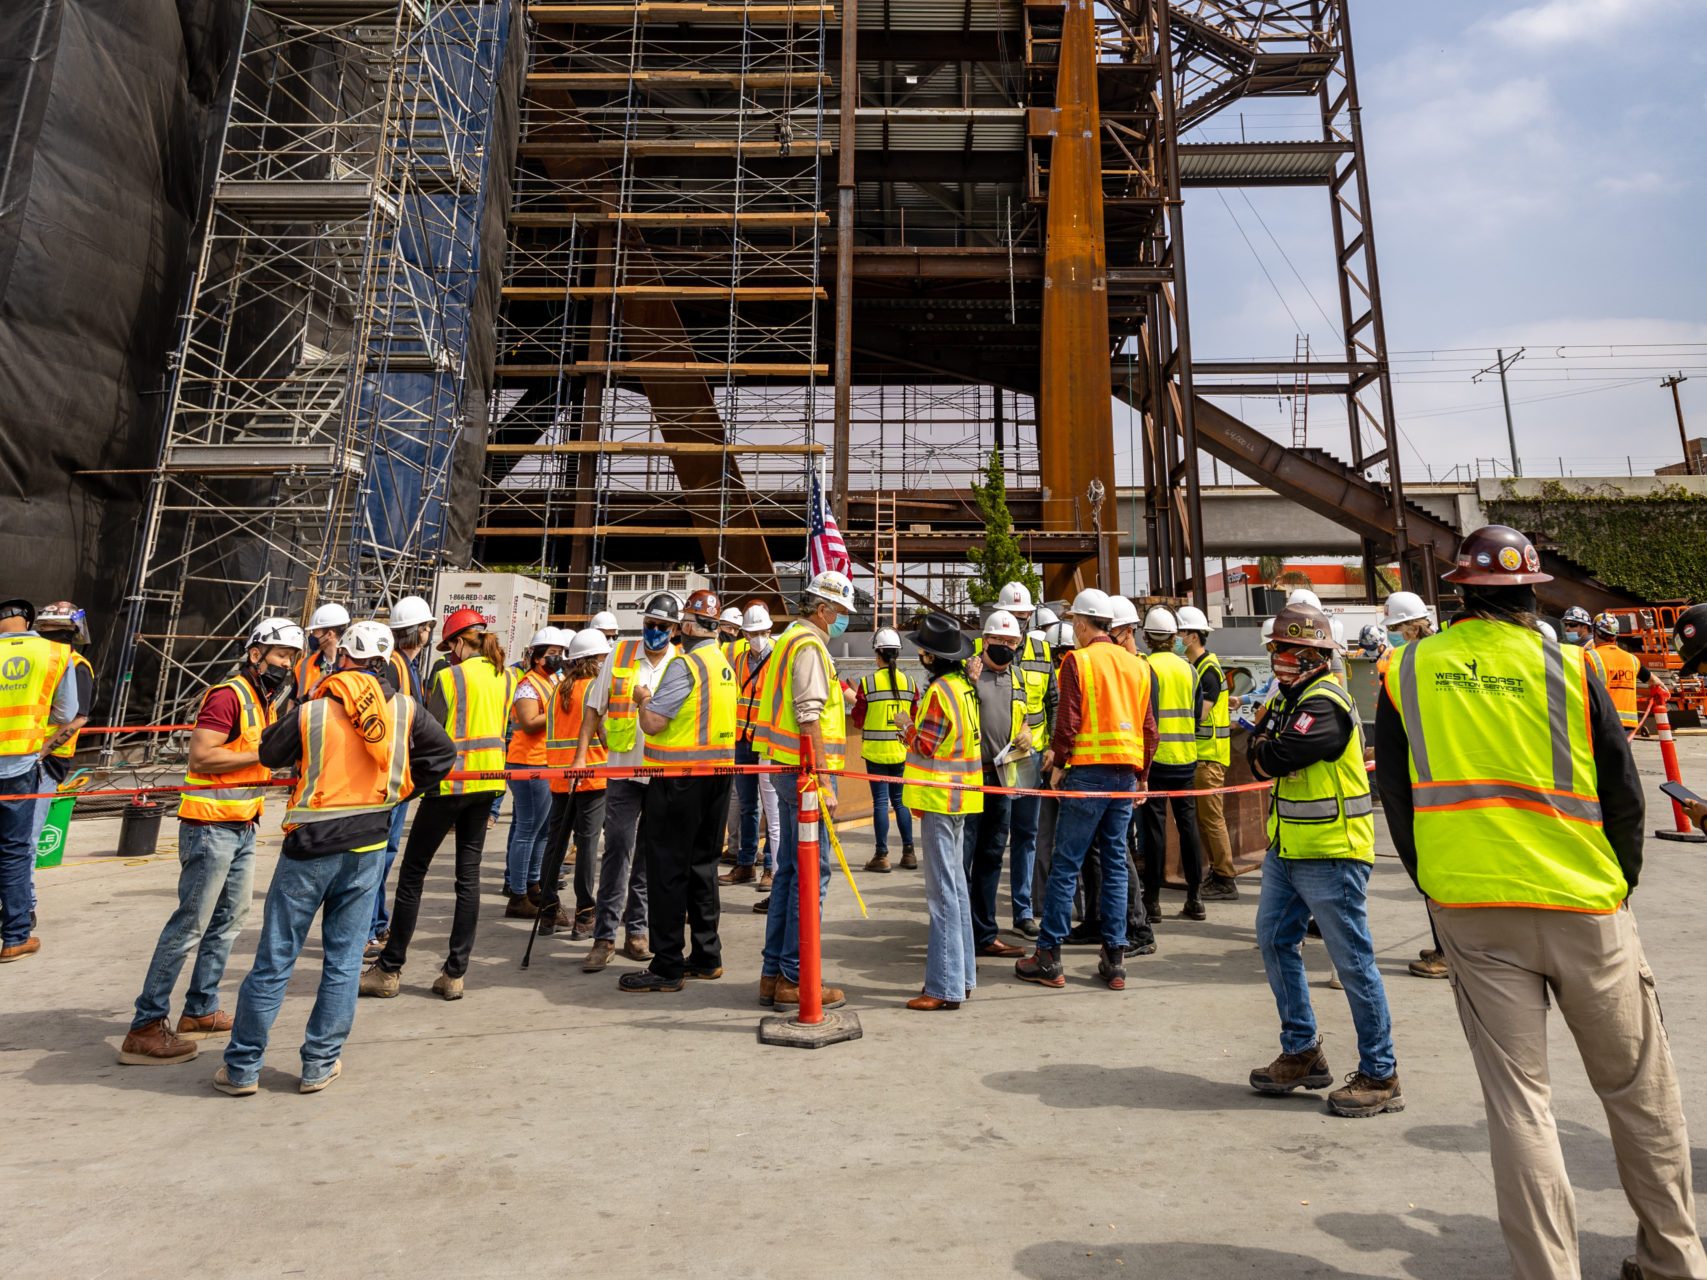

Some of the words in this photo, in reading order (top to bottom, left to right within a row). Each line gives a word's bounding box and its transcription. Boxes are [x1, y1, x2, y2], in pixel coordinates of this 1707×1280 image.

[449, 593, 496, 601] 1-866-RED-D-ARC
[1435, 672, 1468, 681] WEST
[1481, 675, 1523, 687] COAST
[1436, 680, 1480, 689] INSPECTION
[1484, 683, 1524, 693] SERVICES
[713, 766, 744, 776] DANGER
